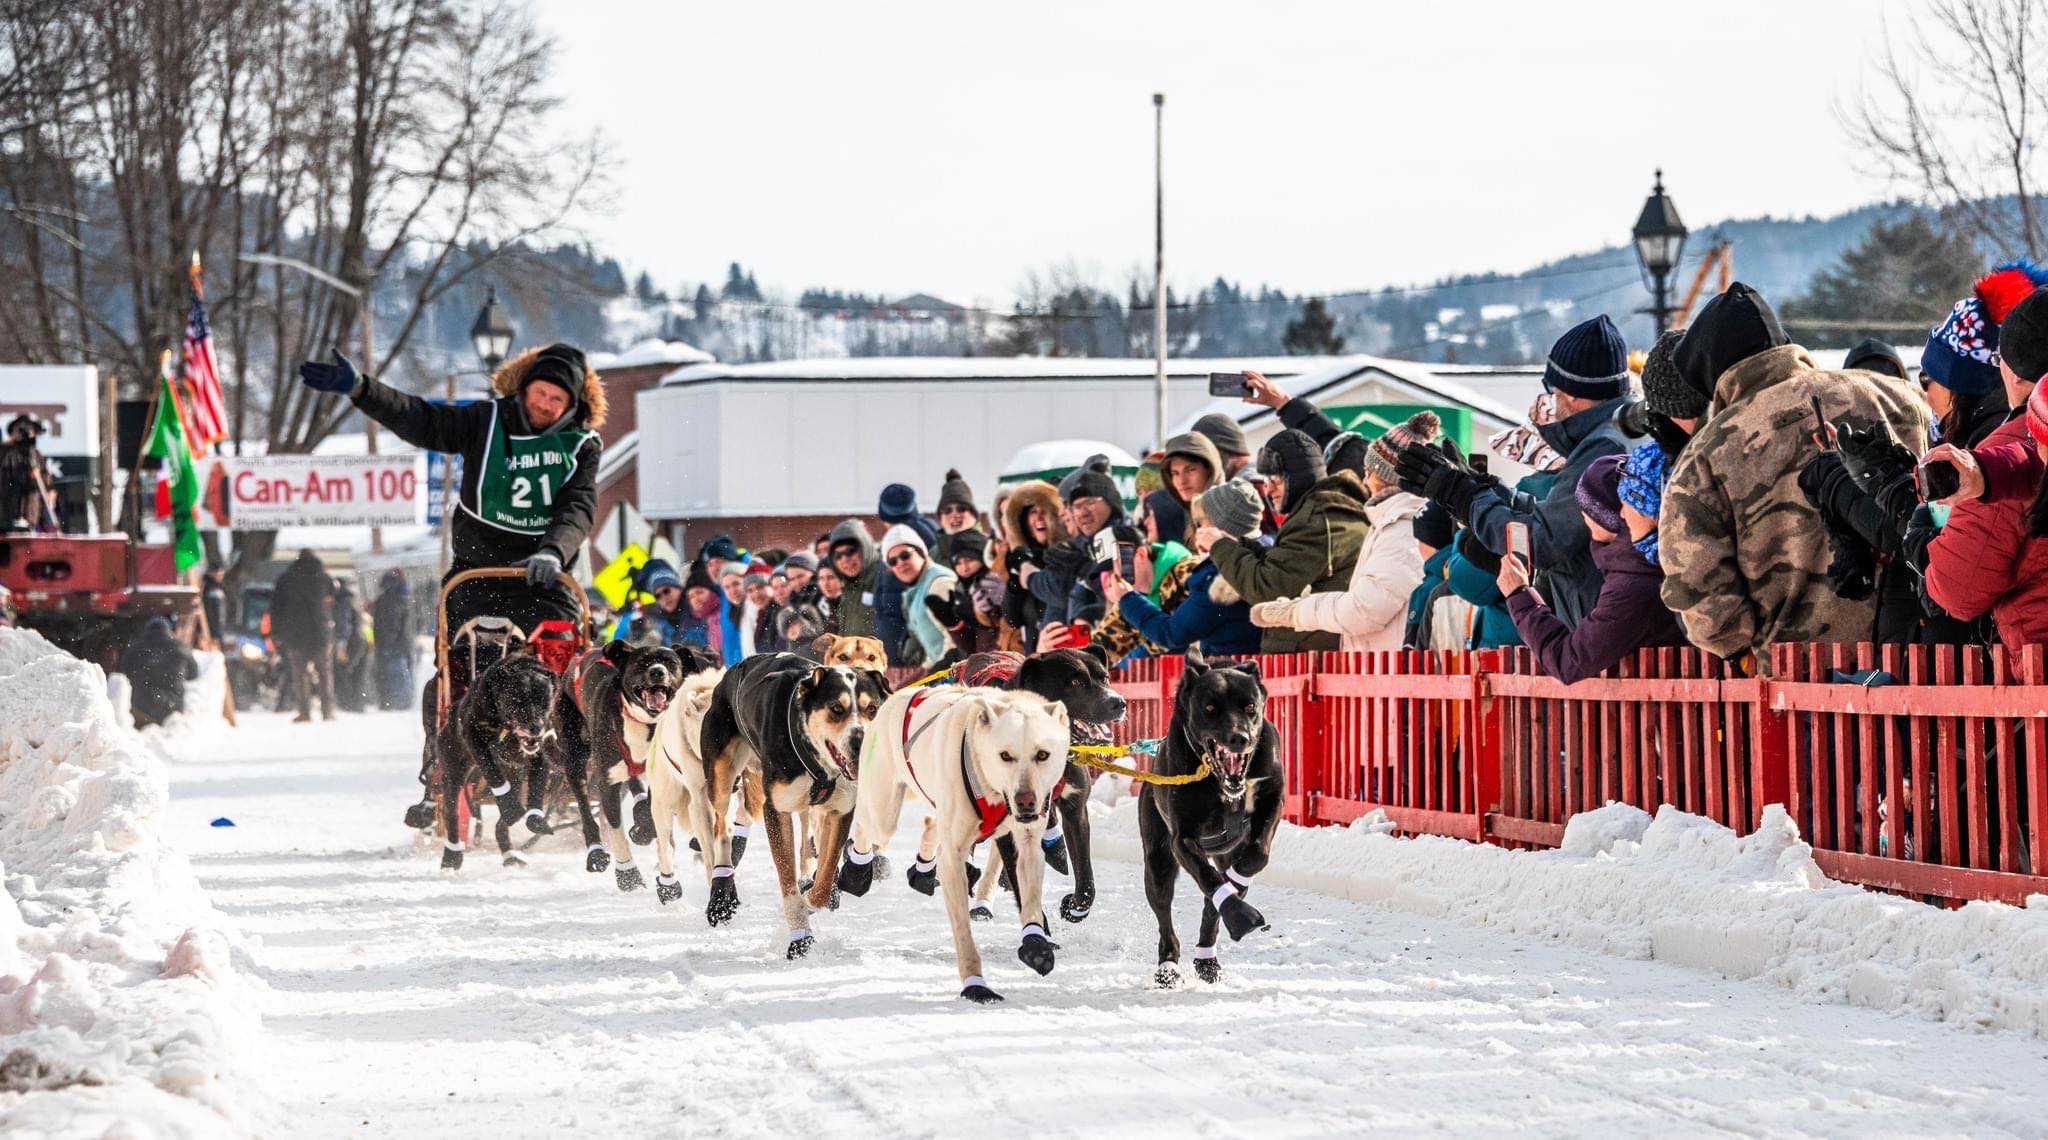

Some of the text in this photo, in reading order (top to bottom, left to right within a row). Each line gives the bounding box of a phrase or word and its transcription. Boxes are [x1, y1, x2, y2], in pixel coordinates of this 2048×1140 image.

[543, 450, 563, 466] 100
[234, 470, 353, 503] Can-Am
[364, 469, 416, 502] 100
[511, 473, 553, 508] 21
